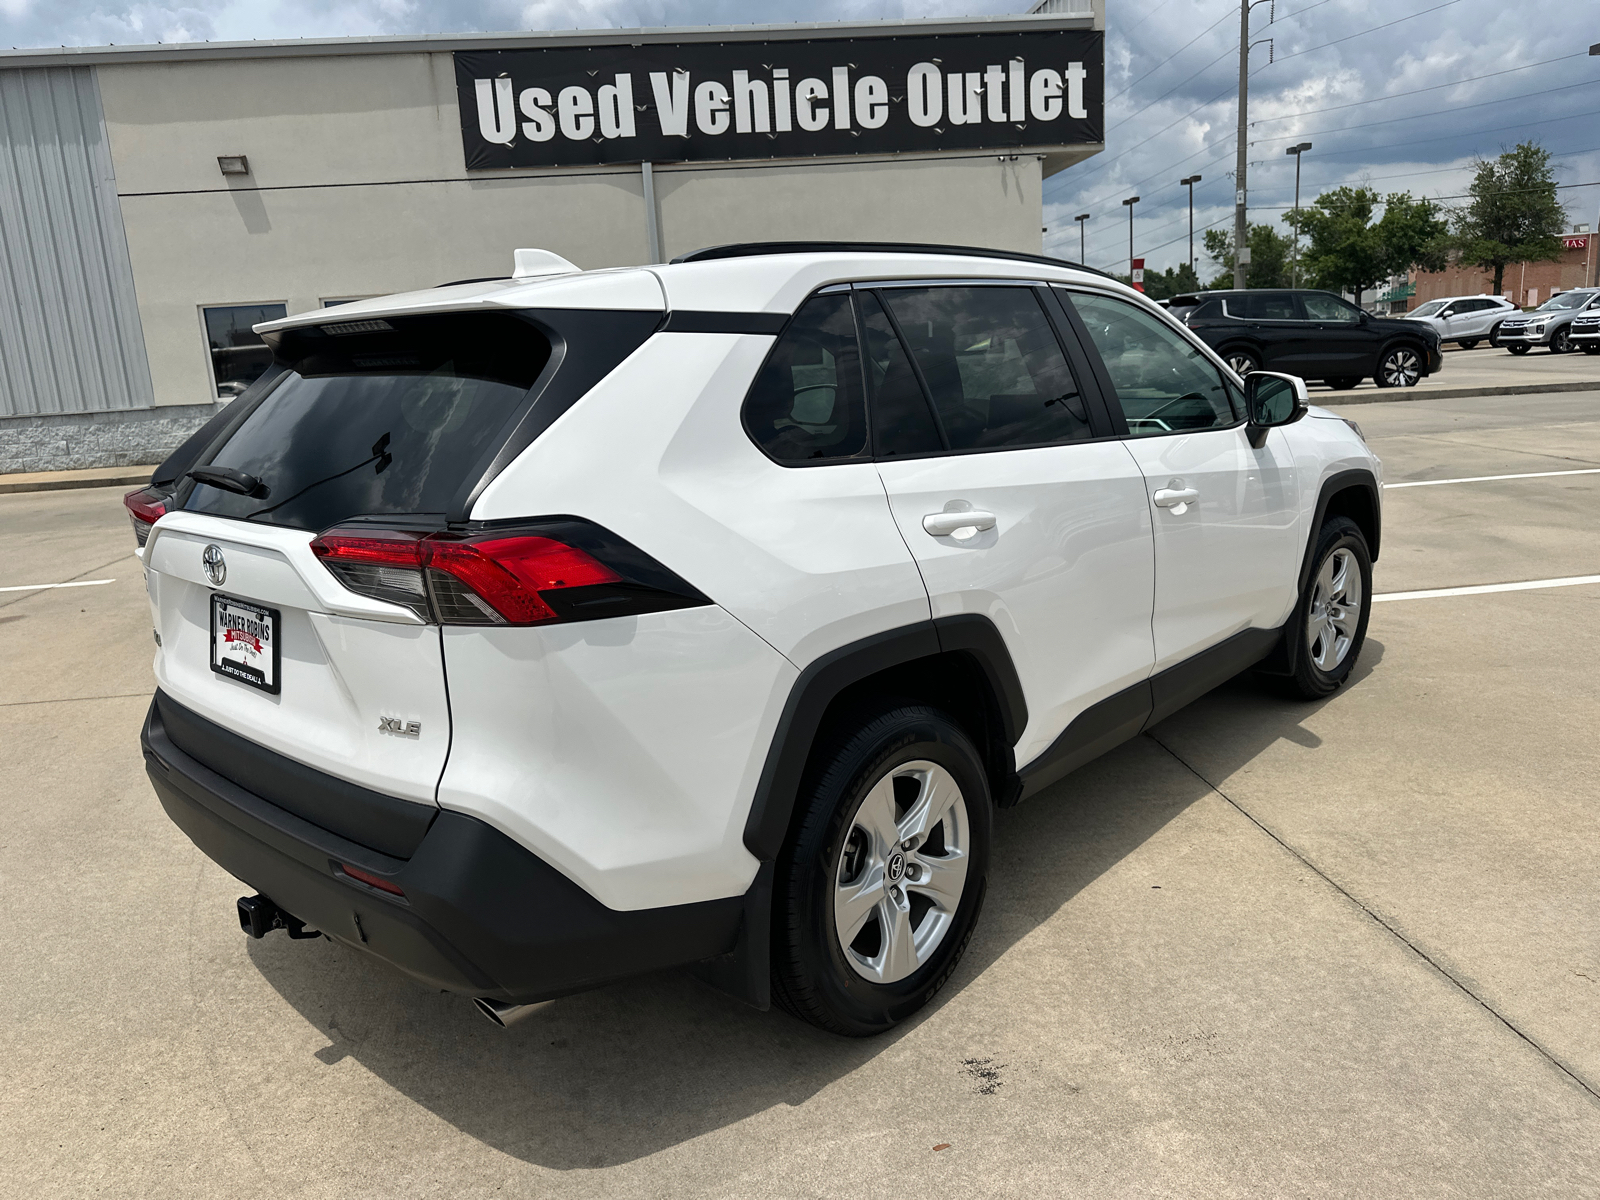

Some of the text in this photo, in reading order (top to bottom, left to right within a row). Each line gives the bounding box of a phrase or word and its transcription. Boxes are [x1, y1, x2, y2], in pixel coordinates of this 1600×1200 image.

[474, 60, 1087, 144] Used Vehicle Outlet
[219, 611, 270, 641] WARNER ROBINS
[225, 665, 234, 674] JUST
[377, 716, 421, 736] XLE
